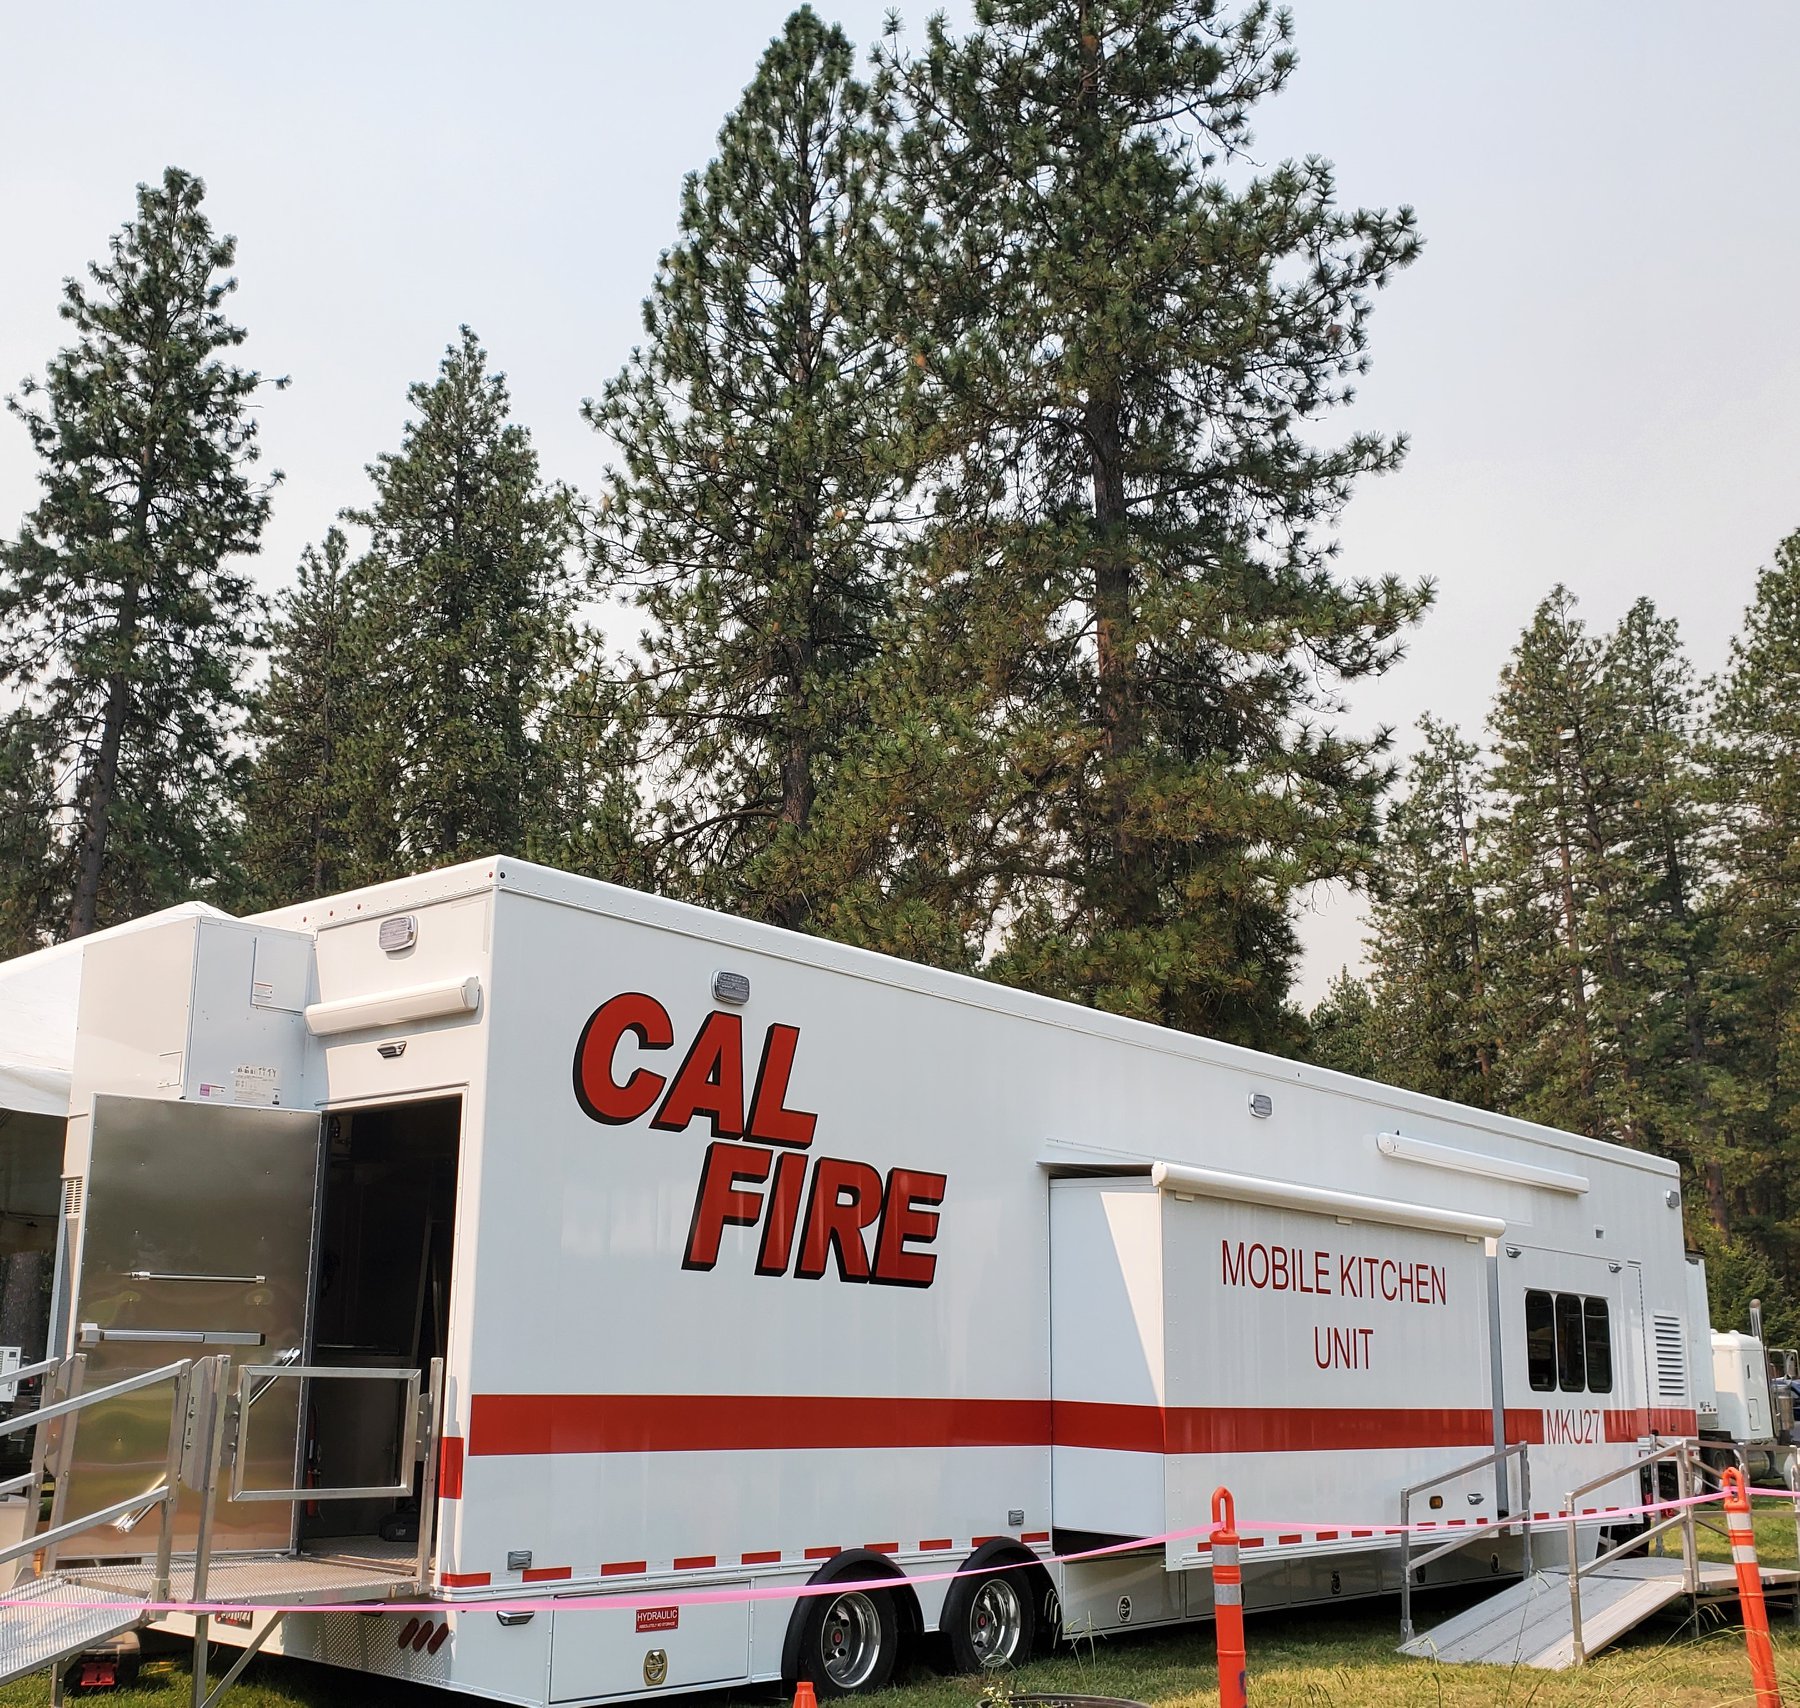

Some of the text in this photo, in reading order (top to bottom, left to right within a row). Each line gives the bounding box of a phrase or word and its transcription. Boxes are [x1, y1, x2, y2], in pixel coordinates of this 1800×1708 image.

[573, 992, 818, 1150] CAL
[681, 1141, 947, 1289] FIRE
[1221, 1239, 1447, 1306] MOBILE KITCHEN
[1314, 1326, 1375, 1370] UNIT
[1547, 1409, 1600, 1445] MKU27
[637, 1610, 677, 1622] HYDRAULIC
